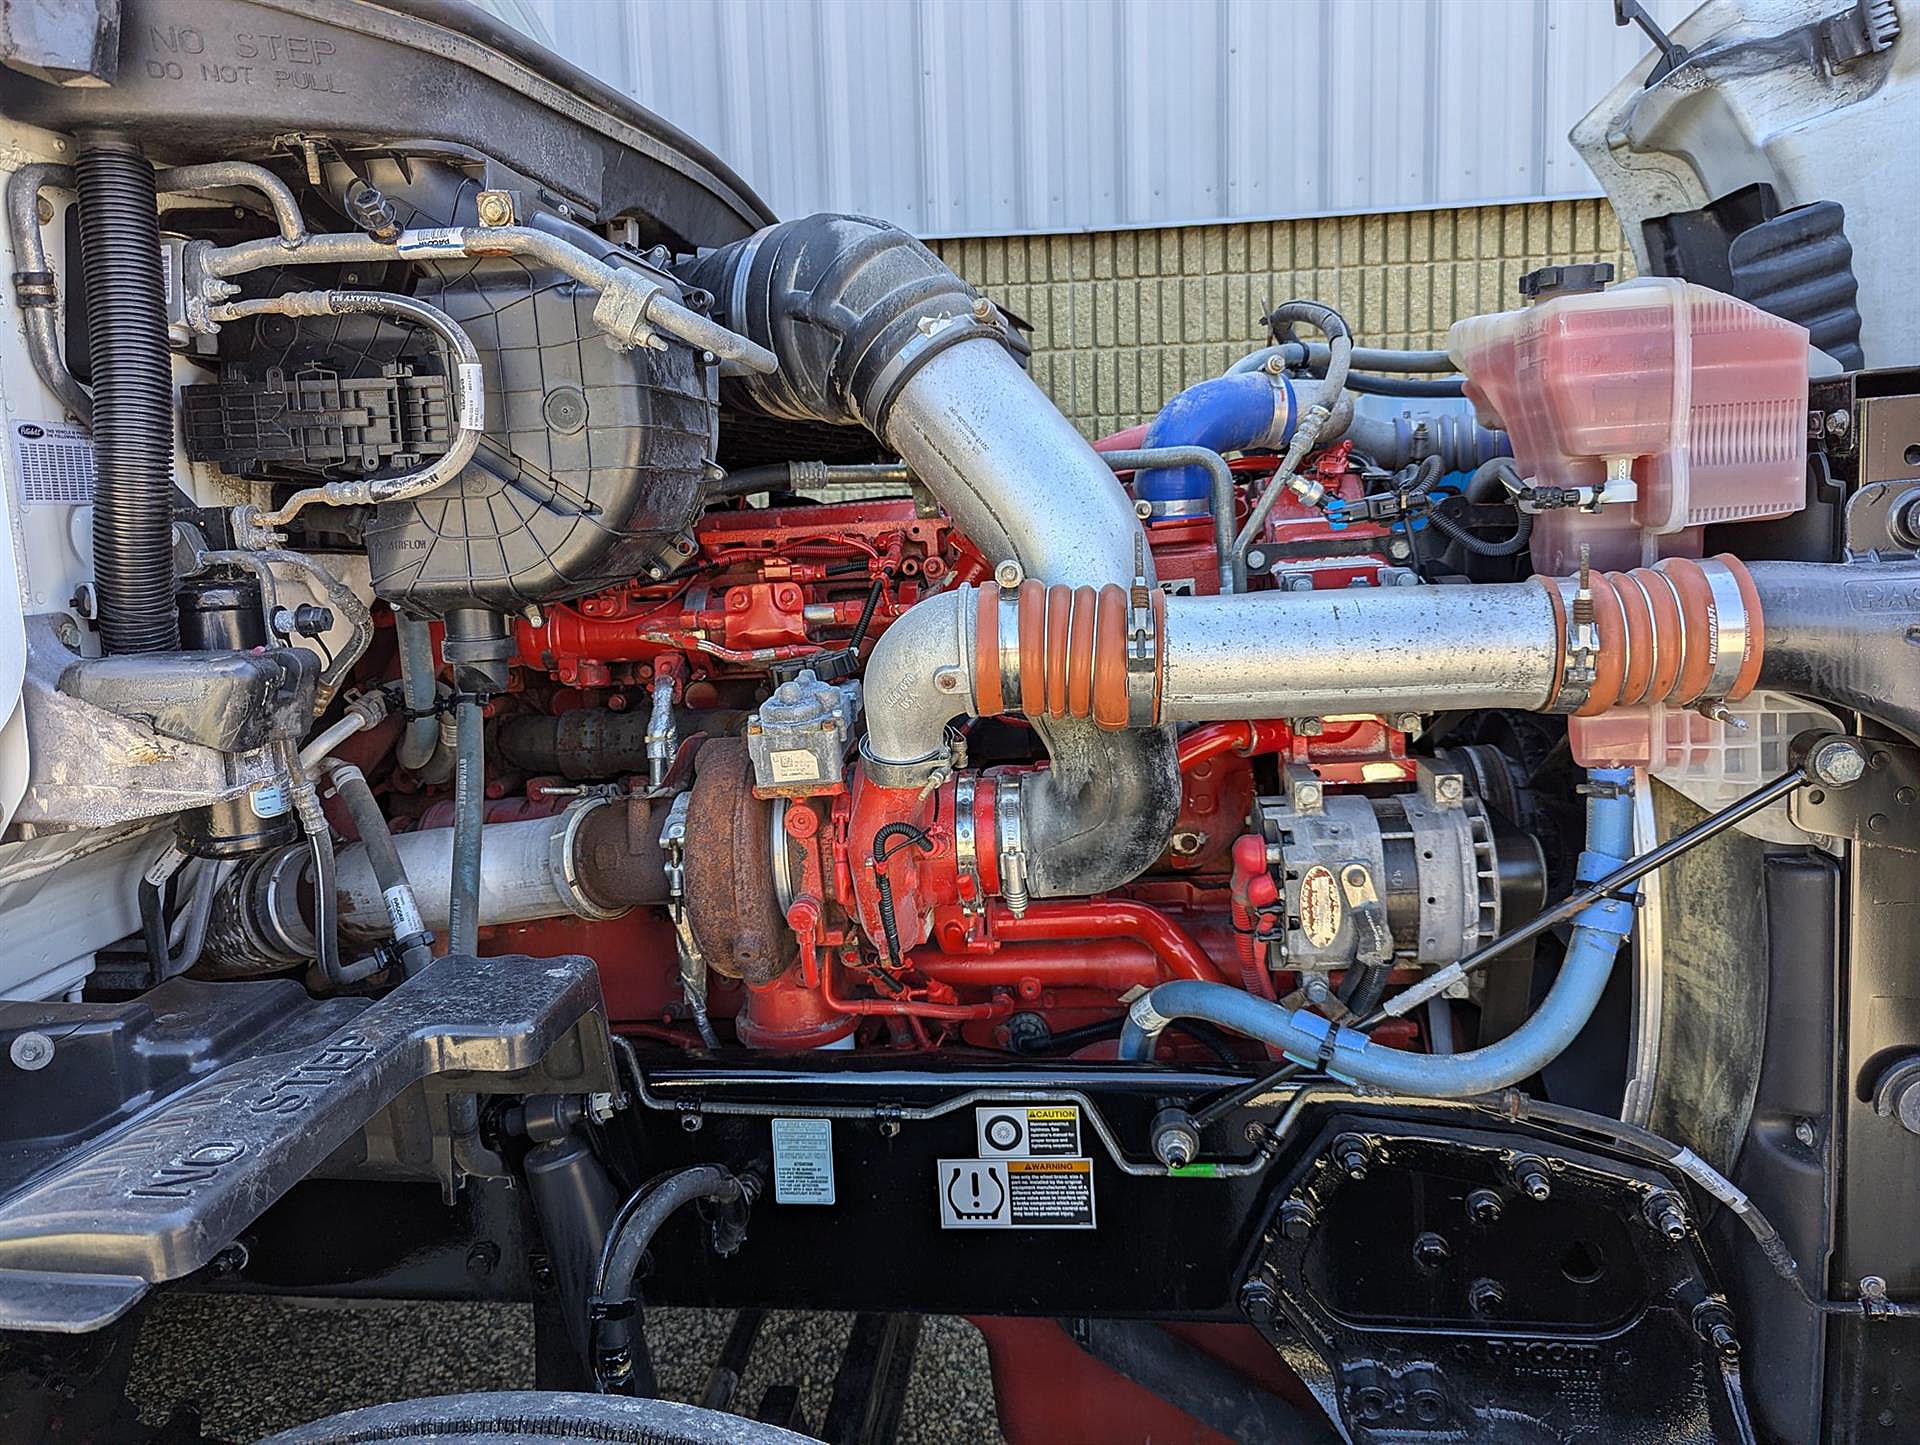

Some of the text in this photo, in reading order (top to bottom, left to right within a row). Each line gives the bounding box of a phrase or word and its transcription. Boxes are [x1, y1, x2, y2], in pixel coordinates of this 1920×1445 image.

[149, 24, 337, 66] NO STEP
[146, 61, 347, 95] DO NOT PULL
[126, 1033, 377, 1199] NO STEP
